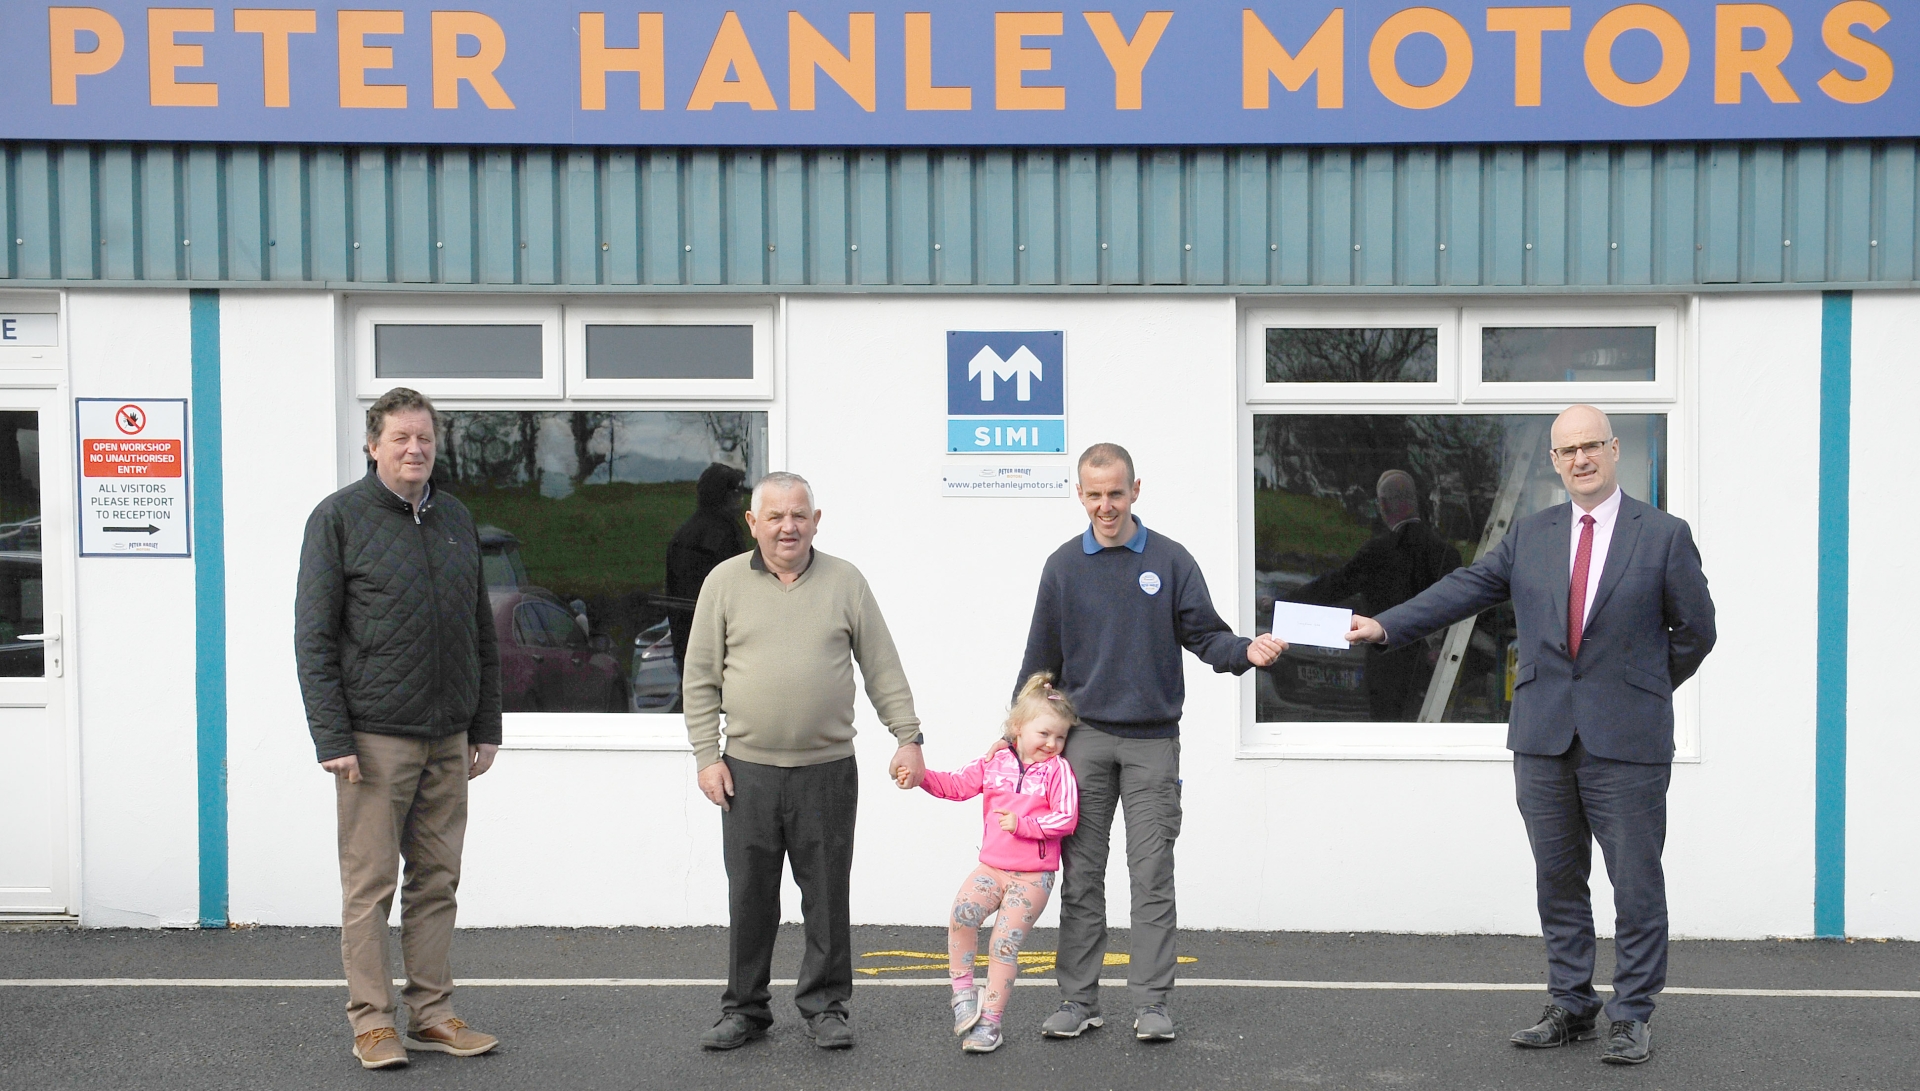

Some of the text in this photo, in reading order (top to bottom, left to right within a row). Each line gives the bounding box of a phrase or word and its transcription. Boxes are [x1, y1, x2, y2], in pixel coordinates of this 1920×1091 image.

[49, 0, 1894, 112] PETER HANLEY MOTORS
[974, 426, 1039, 447] SIMI
[93, 442, 171, 452] OPEN WORKSHOP
[90, 454, 175, 463] NO UNAUTHORISED
[117, 465, 148, 474] ENTRY
[98, 484, 166, 493] ALL VISITORS
[947, 481, 1064, 490] www.peterhanleymotors.ie
[91, 497, 175, 506] PLEASE REPORT
[96, 510, 171, 519] TO RECEPTION
